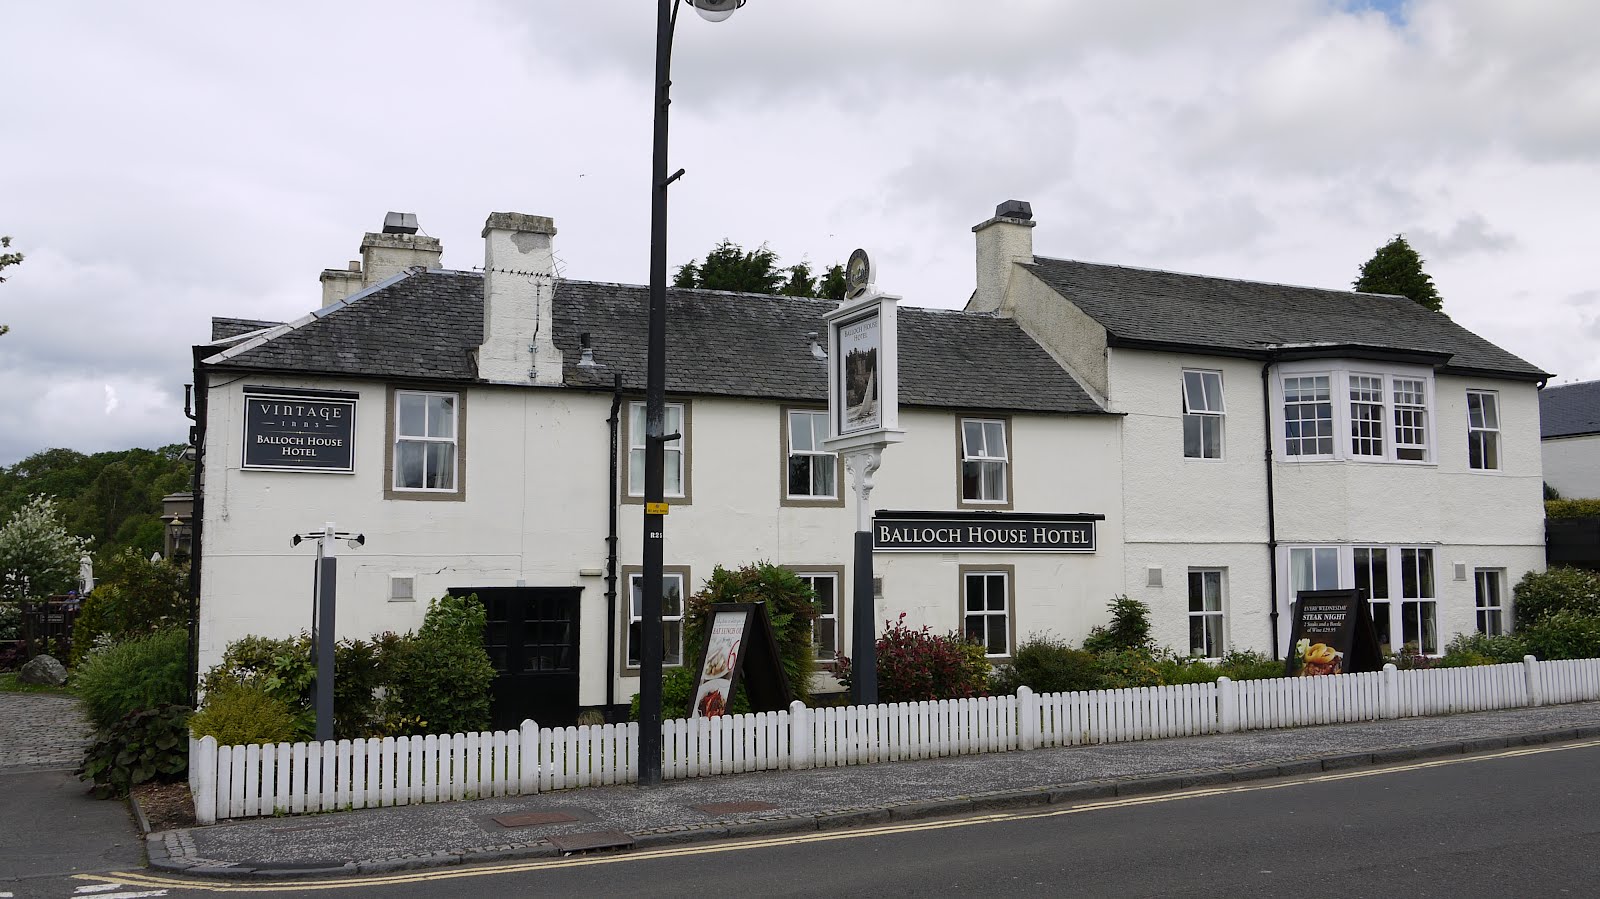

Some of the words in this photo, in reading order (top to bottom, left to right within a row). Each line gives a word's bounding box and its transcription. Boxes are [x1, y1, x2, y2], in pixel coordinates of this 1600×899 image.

[260, 404, 342, 421] VINTAGE
[257, 434, 304, 445] BALLOCH
[307, 437, 343, 447] HOUSE
[282, 447, 317, 456] HOTEL
[879, 525, 962, 543] BALLOCH
[967, 526, 1028, 544] HOUSE
[1032, 527, 1089, 544] HOTEL
